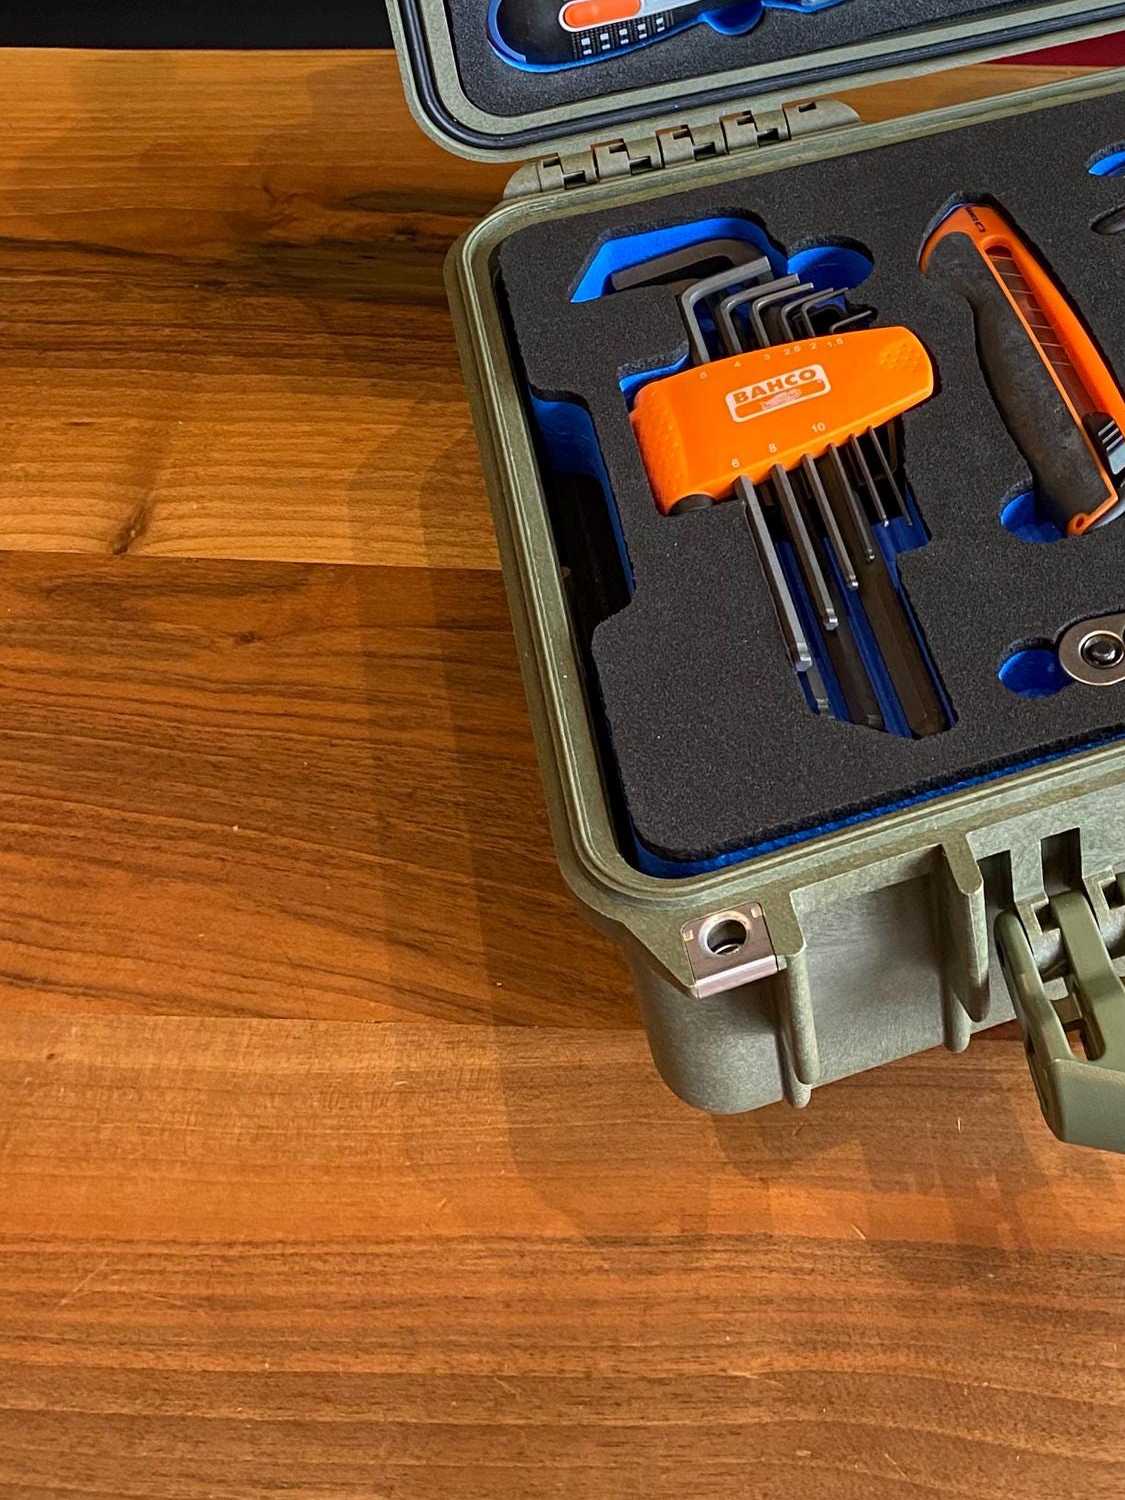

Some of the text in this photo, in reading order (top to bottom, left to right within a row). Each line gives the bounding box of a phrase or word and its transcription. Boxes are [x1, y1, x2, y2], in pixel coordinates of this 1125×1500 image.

[763, 353, 772, 361] 3
[809, 342, 818, 350] 2
[732, 368, 817, 405] BAHCO
[811, 422, 827, 433] 10
[768, 443, 778, 453] 8
[731, 458, 741, 469] 6
